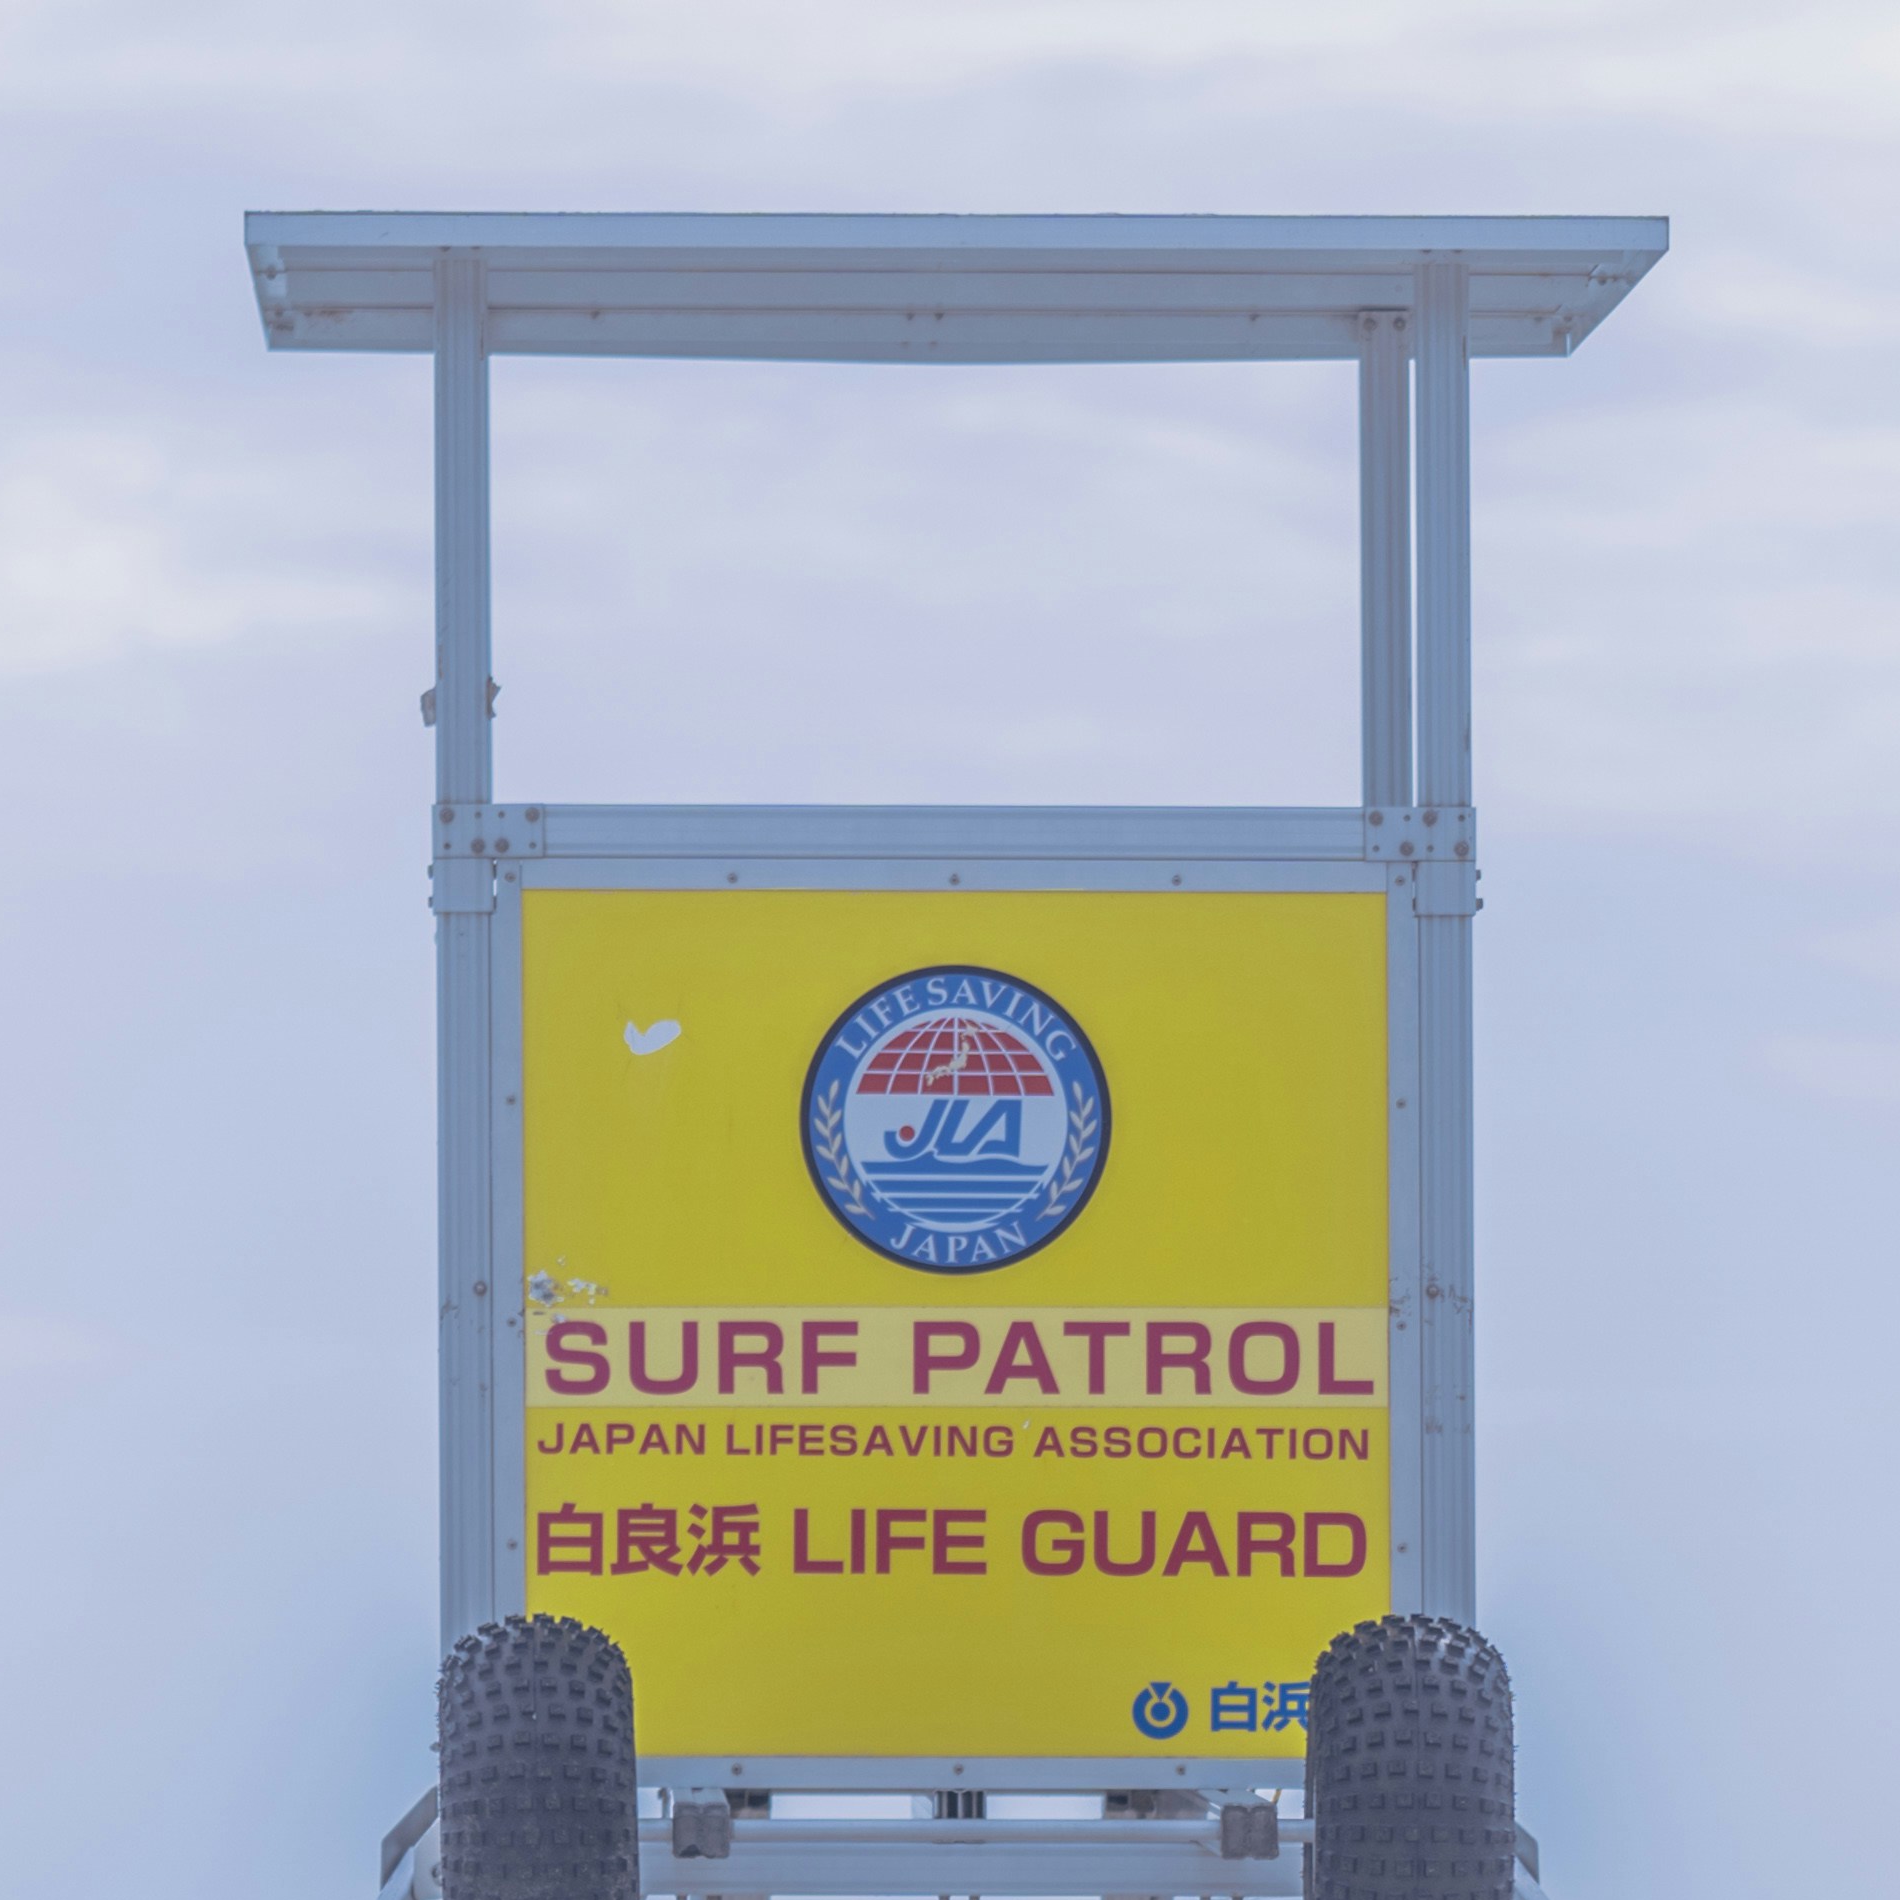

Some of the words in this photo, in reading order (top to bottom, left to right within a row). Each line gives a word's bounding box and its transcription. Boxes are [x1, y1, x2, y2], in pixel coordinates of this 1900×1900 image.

[889, 1220, 1028, 1264] JAPAN
[543, 1316, 859, 1396] SURF
[911, 1318, 1376, 1397] PATROL
[536, 1421, 706, 1456] JAPAN
[724, 1422, 1014, 1459] LIFESAVING
[1032, 1424, 1370, 1461] ASSOCIATION
[535, 1501, 762, 1578] 白良浜
[791, 1506, 988, 1576] LIFE
[1020, 1508, 1369, 1579] GUARD
